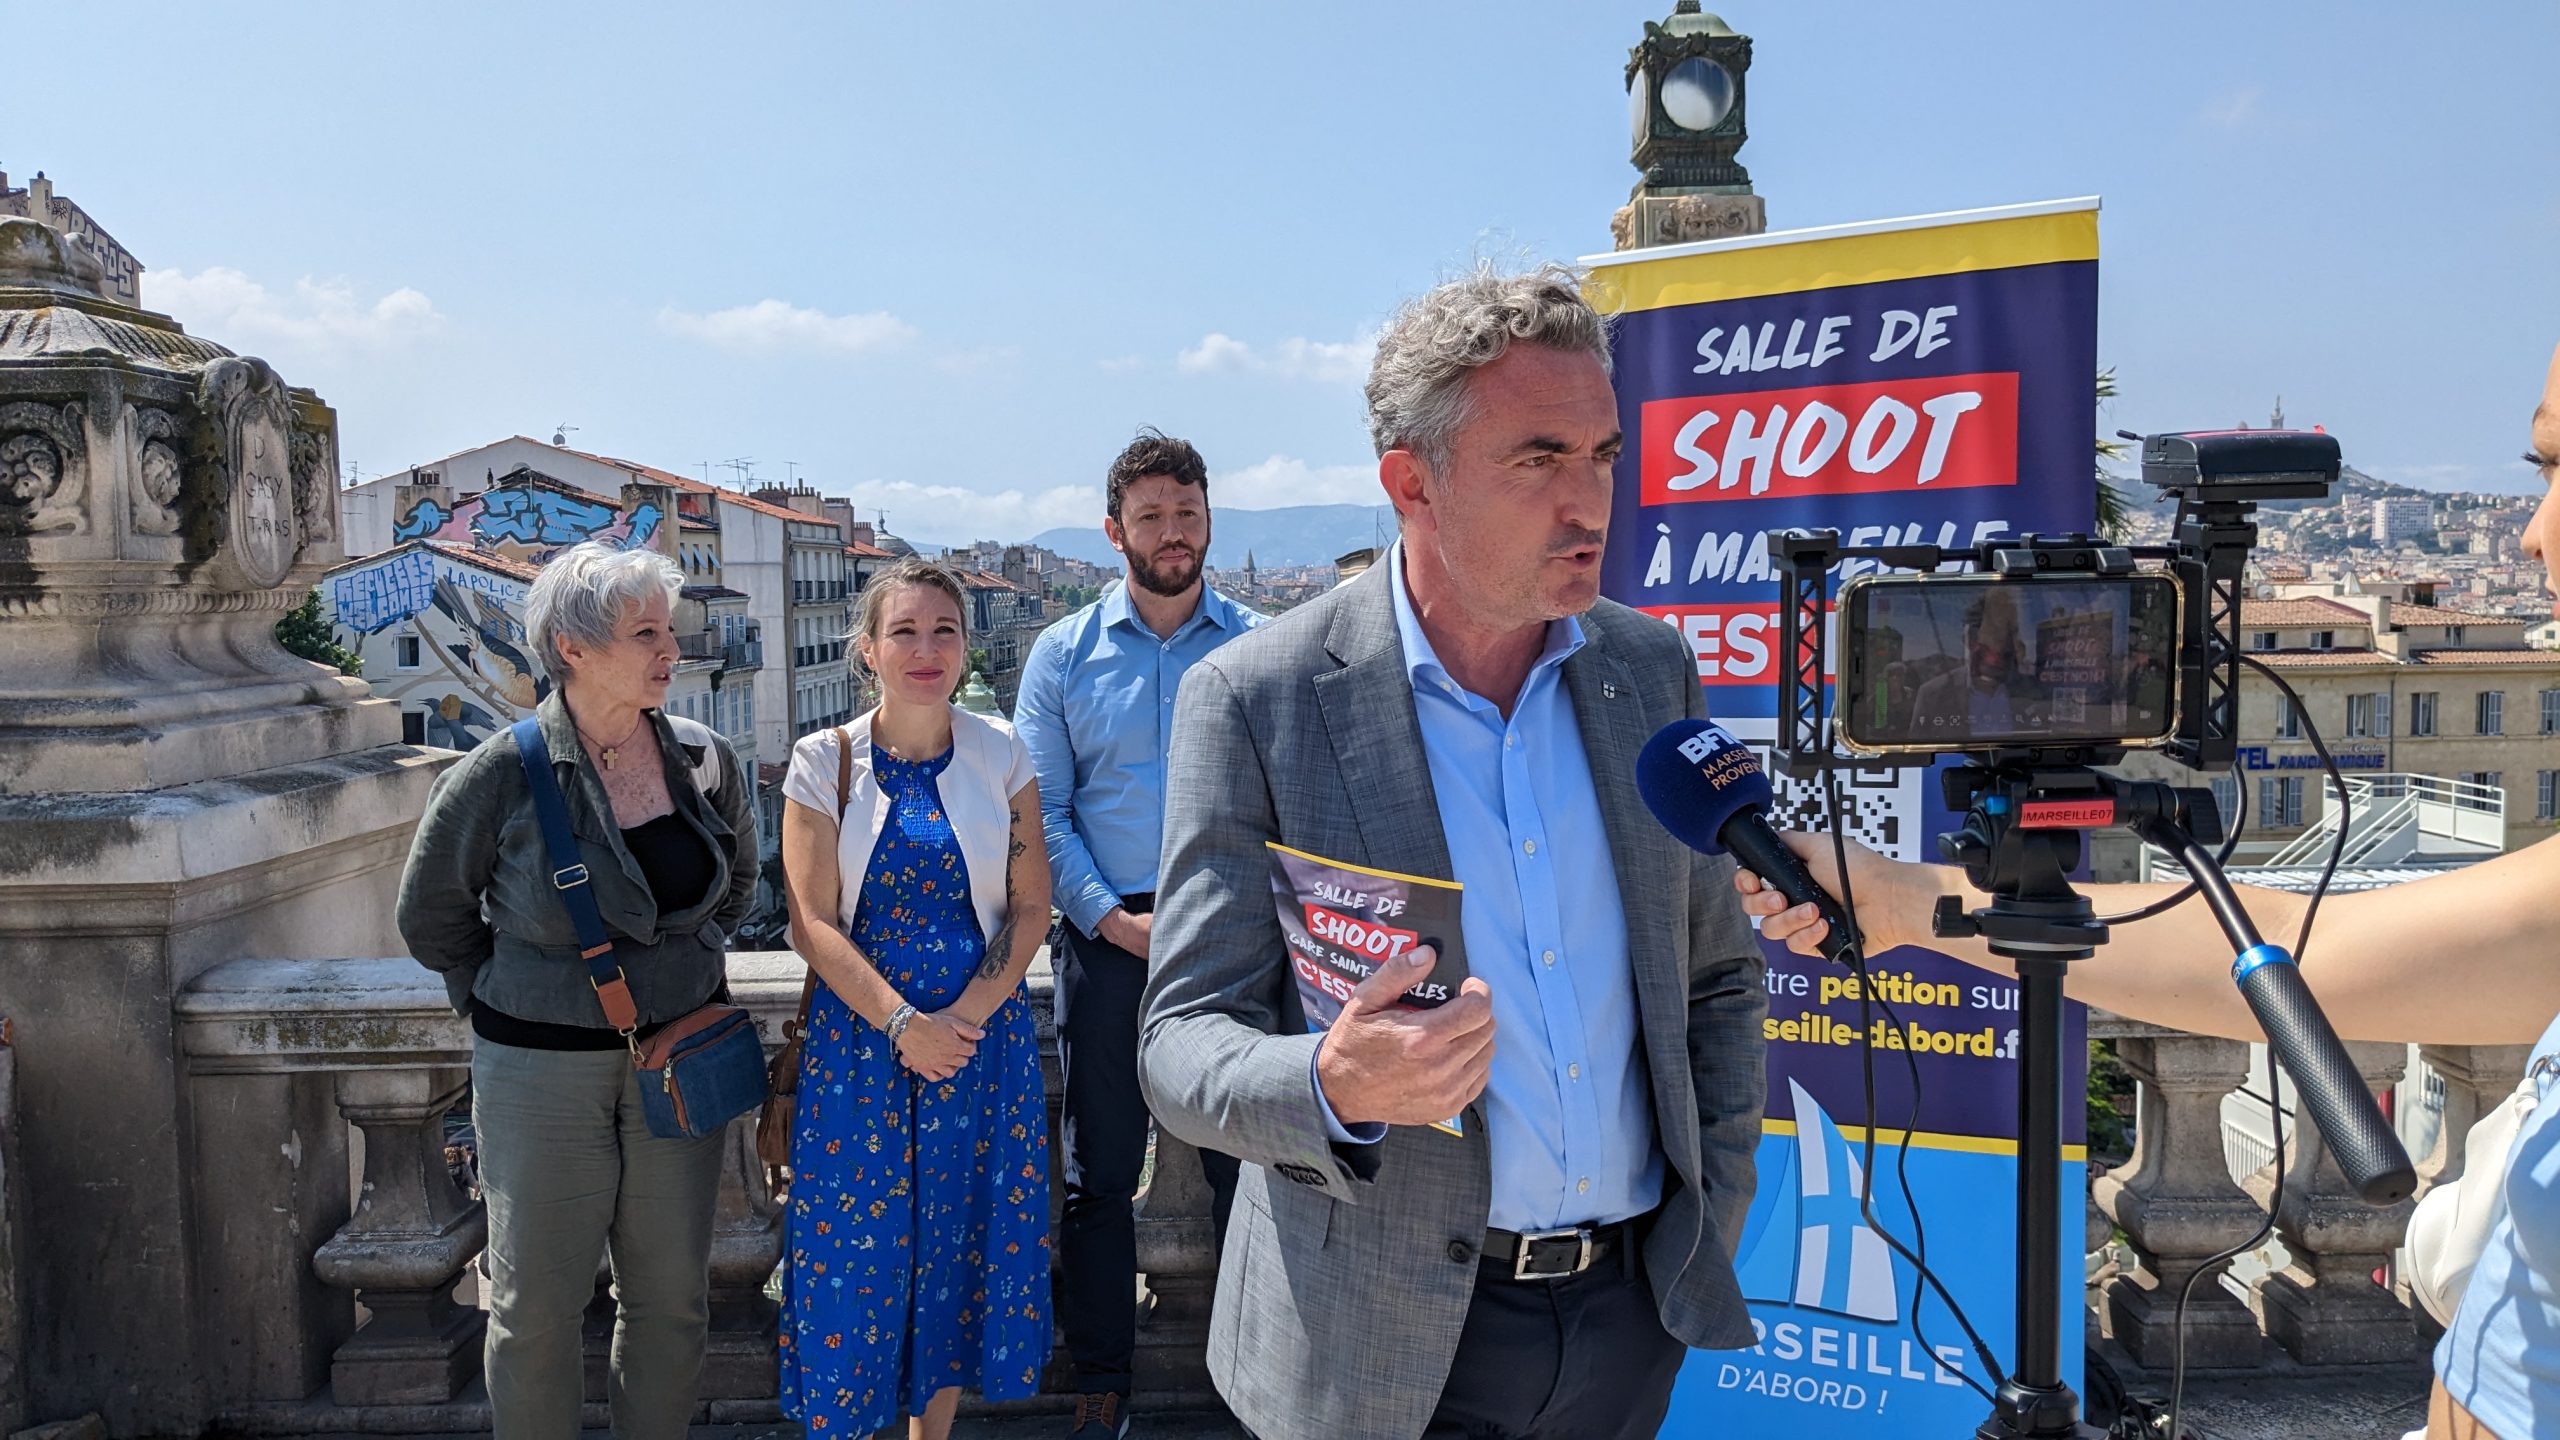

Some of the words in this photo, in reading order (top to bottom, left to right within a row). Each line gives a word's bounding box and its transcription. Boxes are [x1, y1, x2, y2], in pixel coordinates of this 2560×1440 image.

[1693, 315, 1851, 375] SALLE
[1869, 305, 1958, 363] DE
[1667, 391, 1982, 496] SHOOT
[335, 552, 434, 602] REFUGEES
[1644, 522, 1671, 587] À
[2236, 747, 2275, 769] TEL
[1313, 881, 1368, 909] SALLE
[1373, 896, 1406, 917] DE
[1289, 933, 1325, 957] GARE
[1312, 911, 1412, 959] SHOOT
[1763, 968, 1809, 996] tre
[1763, 1011, 2019, 1059] seille-dabord.f
[1738, 1317, 1964, 1387] RSEILLE
[1717, 1363, 1866, 1410] D'ABORD
[1875, 1389, 1889, 1415] !
